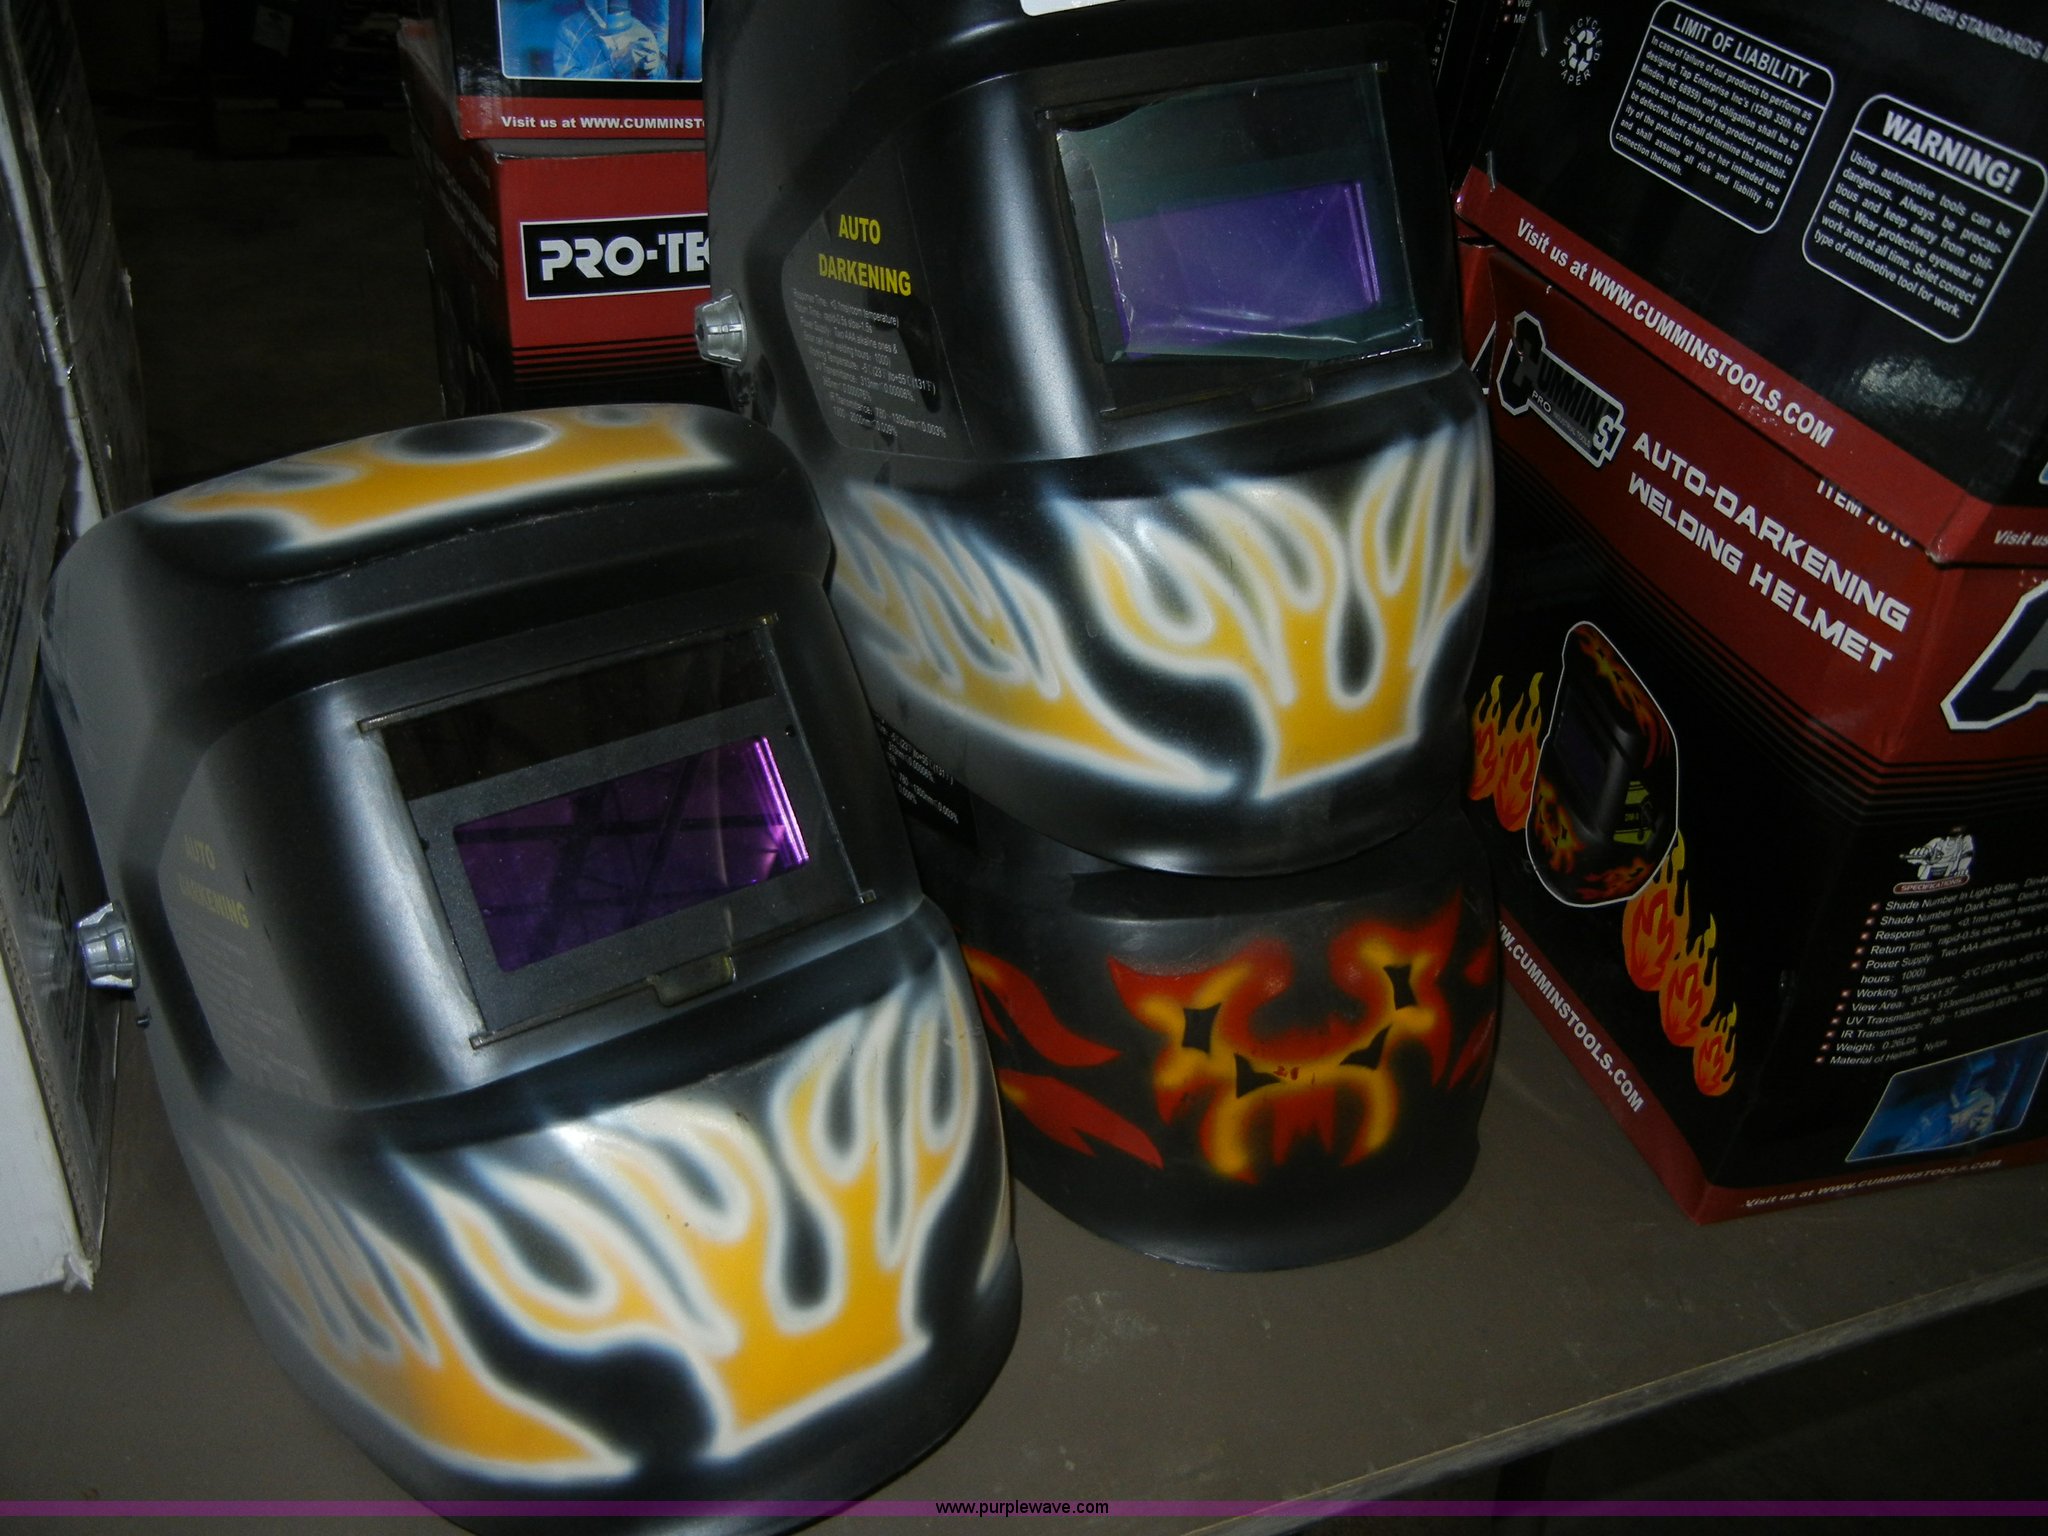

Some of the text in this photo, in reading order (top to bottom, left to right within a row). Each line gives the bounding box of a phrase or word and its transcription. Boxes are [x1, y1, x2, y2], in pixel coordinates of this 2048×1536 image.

[1563, 17, 1602, 61] RECYCLED
[1672, 13, 1811, 89] LIMIT OF LIABILITY
[1921, 1, 1958, 26] HIGH
[1956, 13, 2044, 59] STANDARDS
[1559, 58, 1592, 86] PAPER
[1646, 50, 1677, 73] designed,
[1679, 65, 1692, 80] Tap
[1692, 72, 1730, 98] Enterprise
[1730, 91, 1750, 109] Inc's
[1773, 112, 1793, 129] 35th
[1793, 122, 1808, 136] Rd
[1651, 35, 1813, 121] In case of failure of our products to perform as
[501, 115, 536, 128] Visit
[540, 118, 557, 128] us
[562, 116, 576, 128] at
[1635, 78, 1794, 166] replace such quantity of the product proven to
[1640, 63, 1665, 84] Minden,
[1667, 76, 1679, 89] NE
[1702, 96, 1719, 112] only
[1719, 105, 1757, 129] obligation
[1757, 124, 1778, 140] shall
[1777, 132, 1789, 146] be
[1789, 139, 1800, 151] to
[1615, 132, 1682, 176] connection therewith.
[1625, 103, 1781, 195] ity of the product for his or her intended use
[1630, 90, 1787, 179] be defective. User shall determine the suitabil-
[1882, 110, 2022, 194] WARNING!
[1620, 119, 1774, 209] and shall assume all risk and liability in
[1842, 167, 2002, 254] dangerous. Always be precau-
[1850, 149, 2012, 239] Using automotive tools can be
[838, 214, 881, 245] AUTO
[1828, 198, 1985, 289] dren. Wear protective eyewear in
[1835, 182, 1993, 270] tious and keep away from chil-
[818, 252, 912, 297] DARKENING
[1814, 228, 1960, 319] type of automotive tool for work.
[1821, 215, 1977, 306] work area at all time. Selet correct
[1516, 218, 1550, 254] Visit
[1549, 245, 1569, 268] us
[1570, 257, 1590, 281] at
[1588, 267, 1834, 448] WWW.CUMMINSTOOLS.COM
[1531, 390, 1552, 413] PRO
[1632, 432, 1911, 632] AUTO-DARKENING
[1993, 530, 2031, 546] Visit
[1628, 471, 1744, 575] WELDING
[1748, 562, 1894, 672] HELMET
[1880, 914, 1915, 925] Shade
[1916, 908, 1953, 923] Number
[1963, 901, 1985, 913] Dark
[1885, 900, 1920, 911] Shade
[1921, 894, 1959, 909] Number
[1969, 886, 1992, 899] Light
[1870, 944, 1906, 955] Return
[1875, 928, 1926, 941] Response
[1865, 960, 1900, 970] Power
[1852, 1002, 1878, 1012] View
[1856, 988, 1899, 998] Working
[1840, 1029, 1855, 1039] IR
[1846, 1015, 1865, 1026] UV
[1830, 1054, 1874, 1065] Material
[1745, 1159, 2003, 1208] Visit us at WWW.CUMMINSTOOLS.COM
